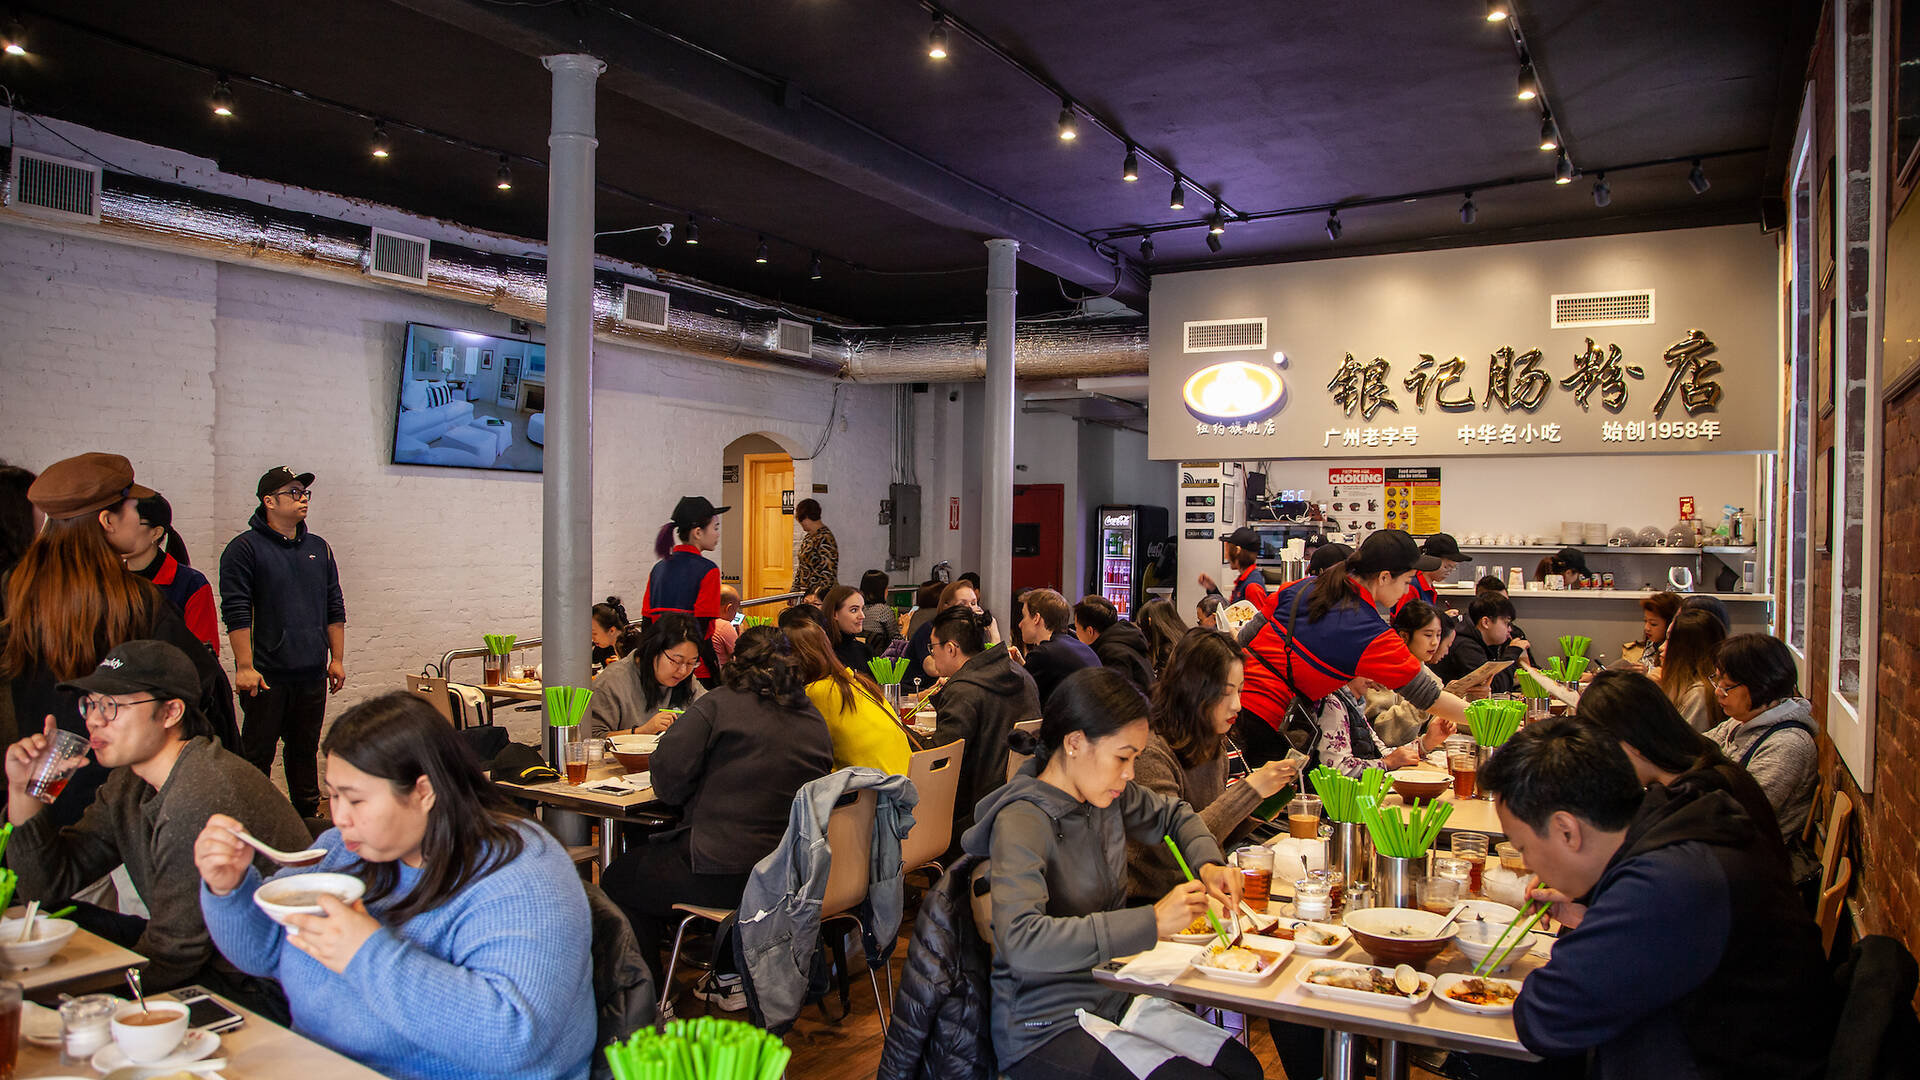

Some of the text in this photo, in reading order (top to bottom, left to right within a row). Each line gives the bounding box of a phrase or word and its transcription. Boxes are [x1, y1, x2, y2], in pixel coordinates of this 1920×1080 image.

[1327, 329, 1723, 420] 银记肠粉店
[1196, 419, 1276, 435] 纽约旗舰店
[1323, 421, 1721, 447] 广州老字号 中华名小吃 始创1958年
[1330, 473, 1382, 484] CHOKING
